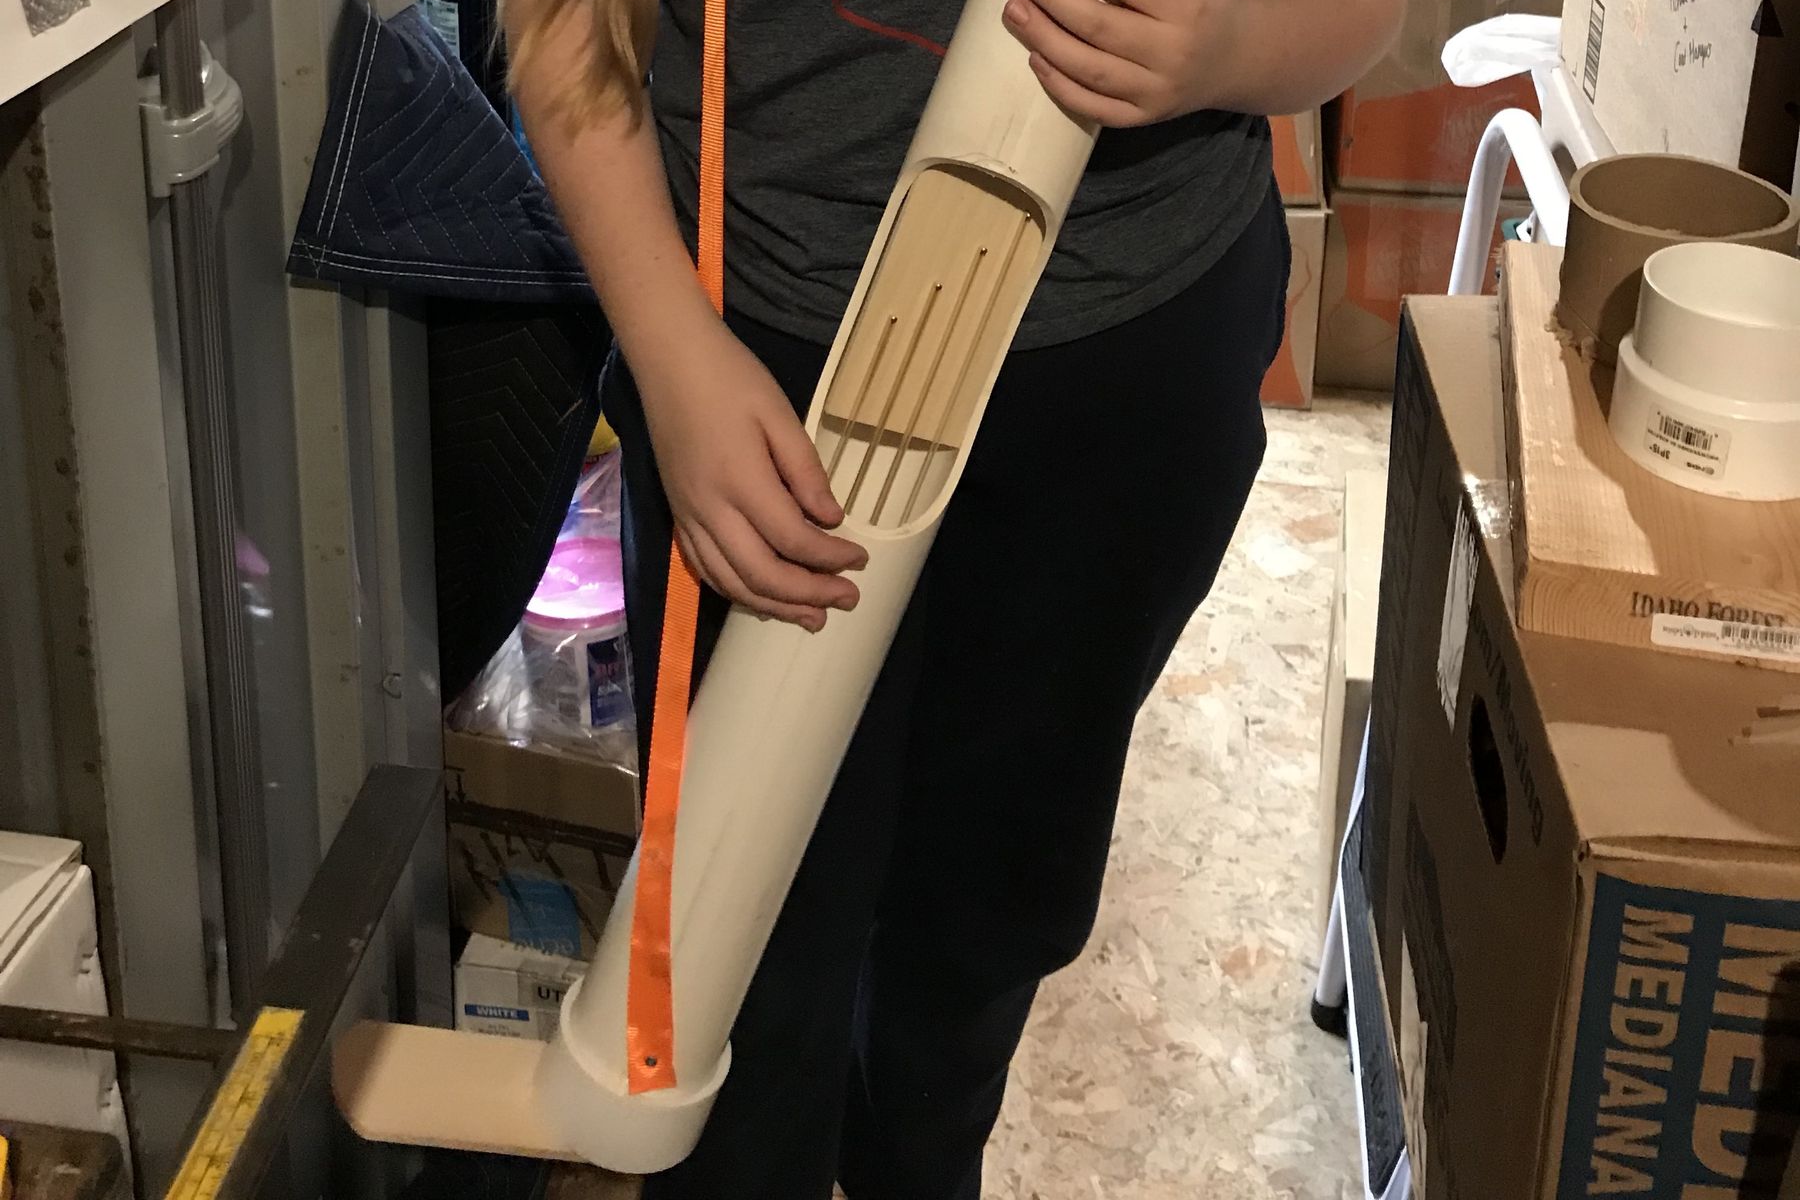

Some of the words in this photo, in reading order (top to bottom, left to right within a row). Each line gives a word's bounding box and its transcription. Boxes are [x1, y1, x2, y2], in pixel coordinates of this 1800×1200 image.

[1631, 591, 1700, 618] IDAHO
[476, 1005, 519, 1019] WHITE
[1586, 903, 1696, 1196] MEDIANA
